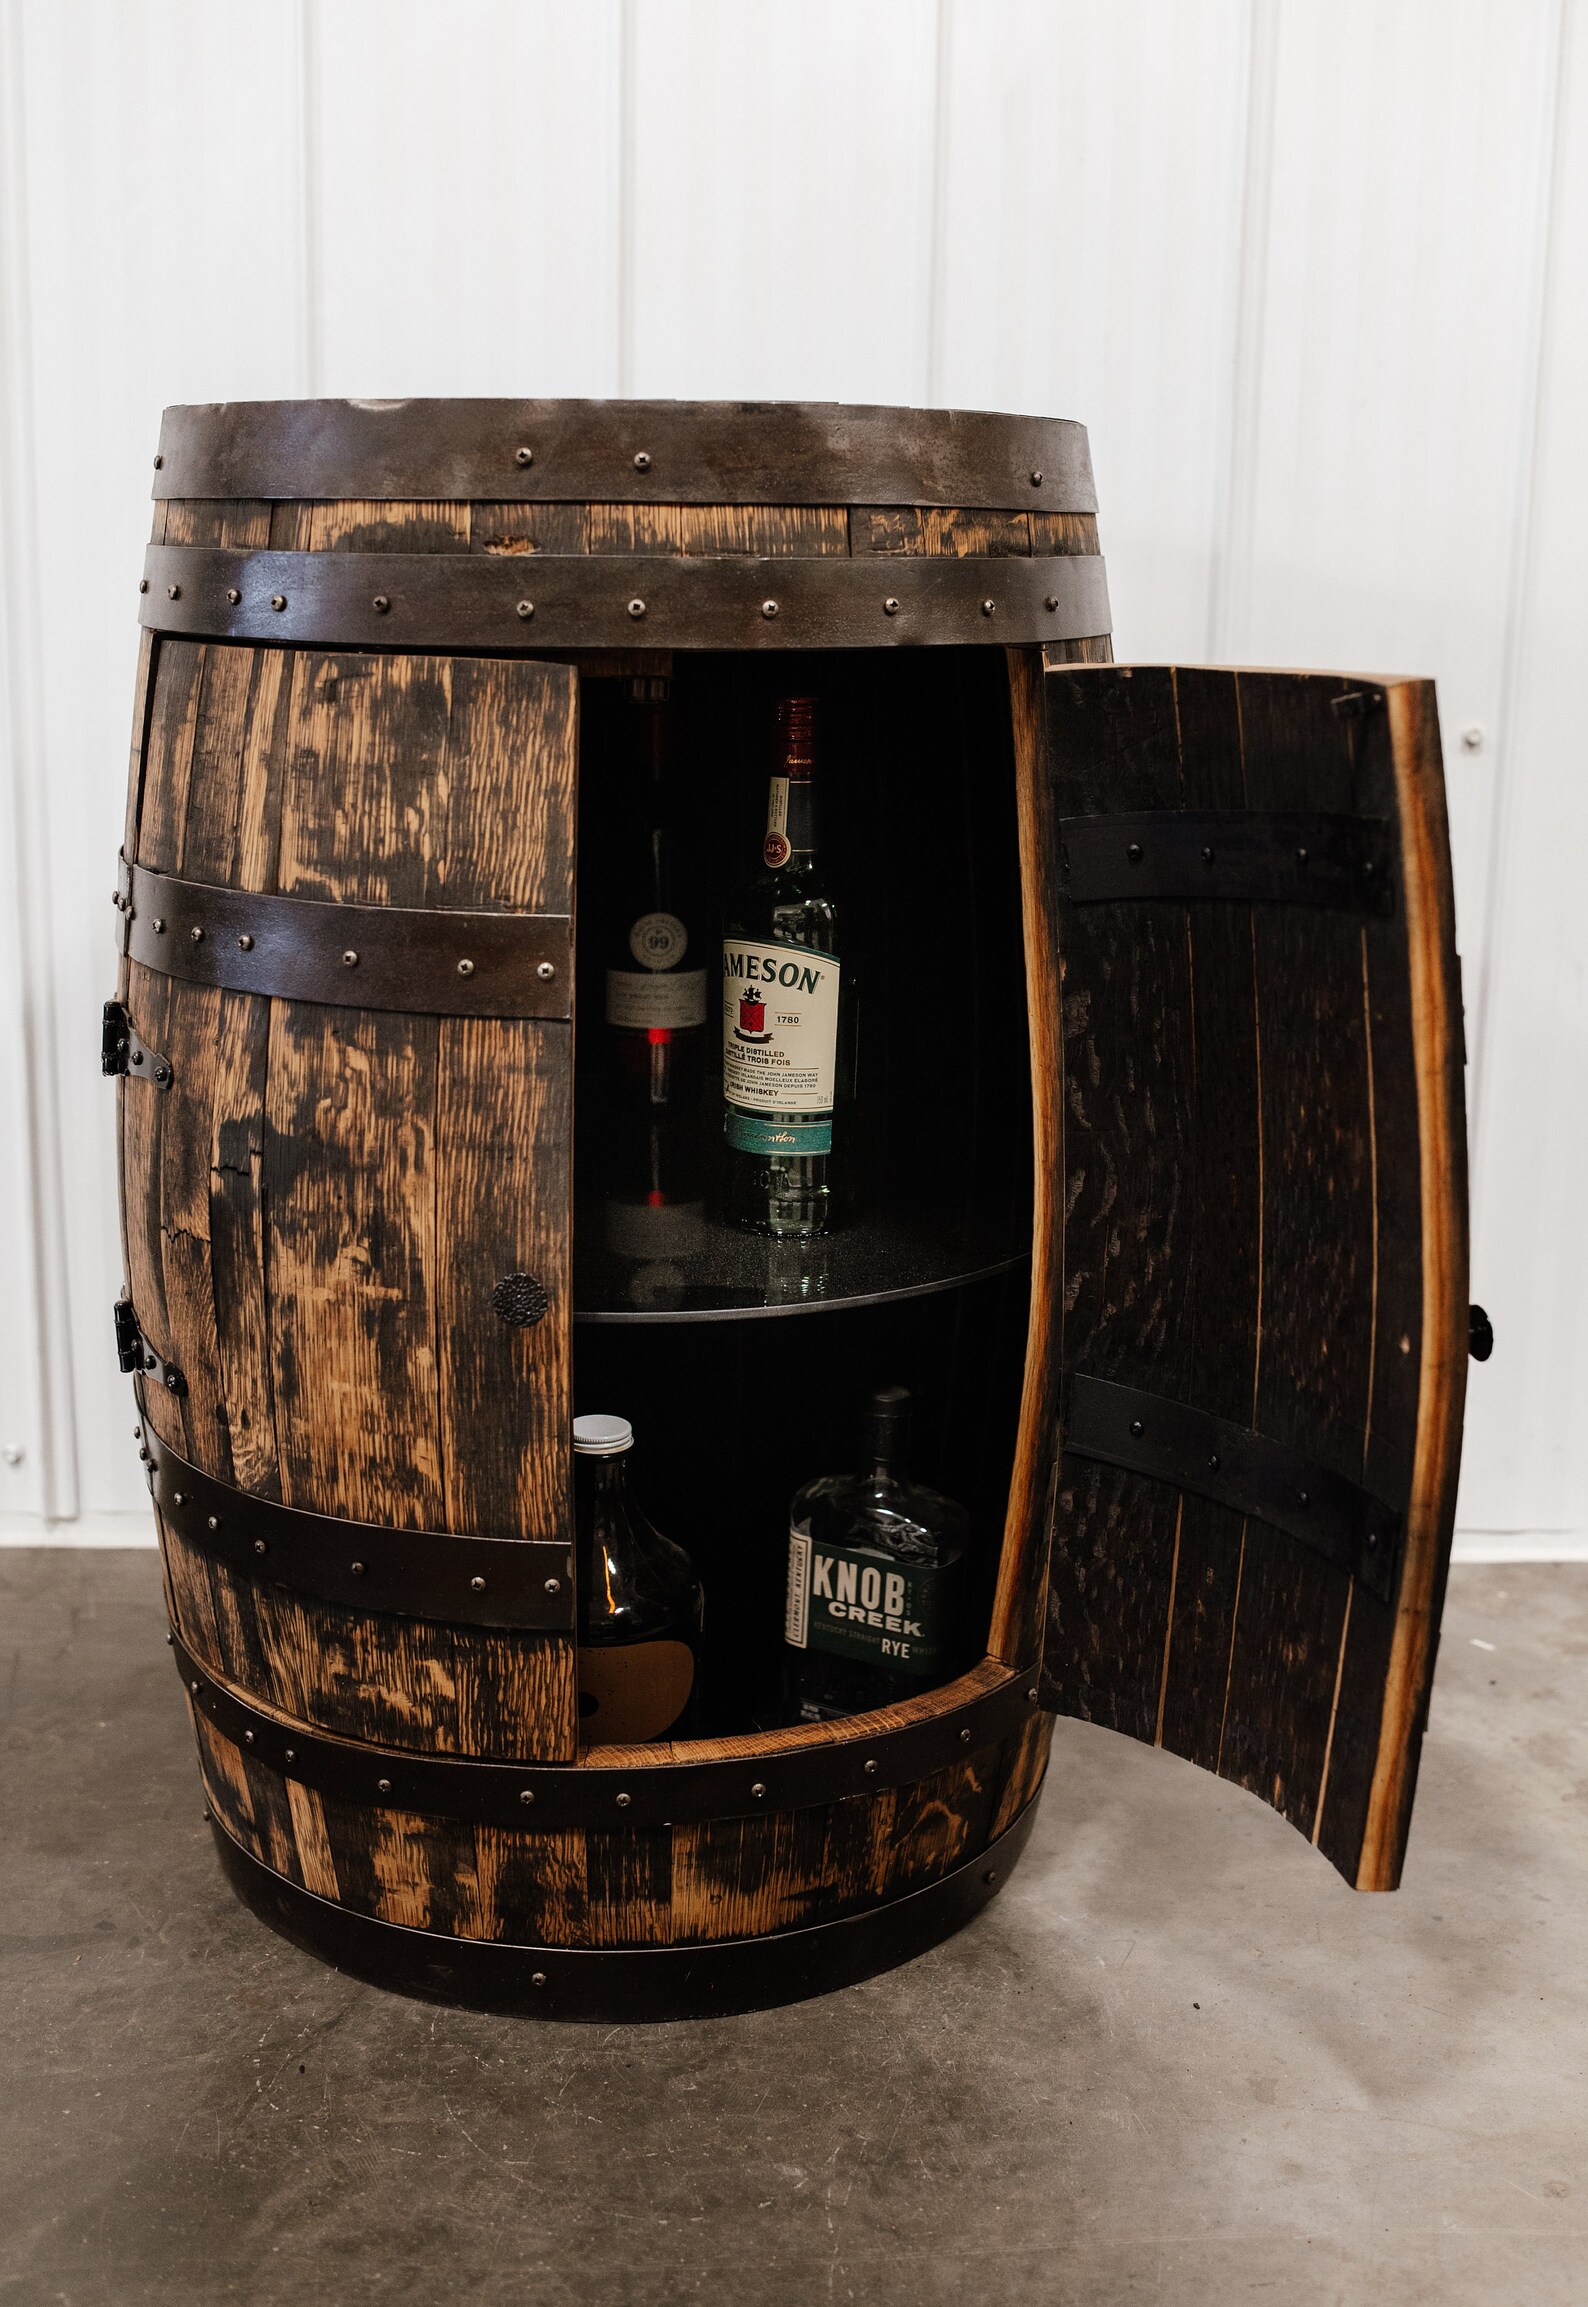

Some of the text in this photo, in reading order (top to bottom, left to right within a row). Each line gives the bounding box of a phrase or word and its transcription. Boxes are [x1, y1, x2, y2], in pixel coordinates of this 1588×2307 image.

[724, 953, 821, 995] AMESON
[777, 1016, 800, 1024] 1780
[728, 1041, 785, 1058] TRIPLE DISTILLED
[747, 1055, 769, 1065] TROIS
[744, 1086, 779, 1097] WHISKEY
[759, 1080, 782, 1088] JAMESON
[794, 1545, 803, 1588] KENTUCKY
[813, 1554, 905, 1617] KNOB
[828, 1601, 923, 1638] CREEK
[881, 1638, 911, 1659] RYE
